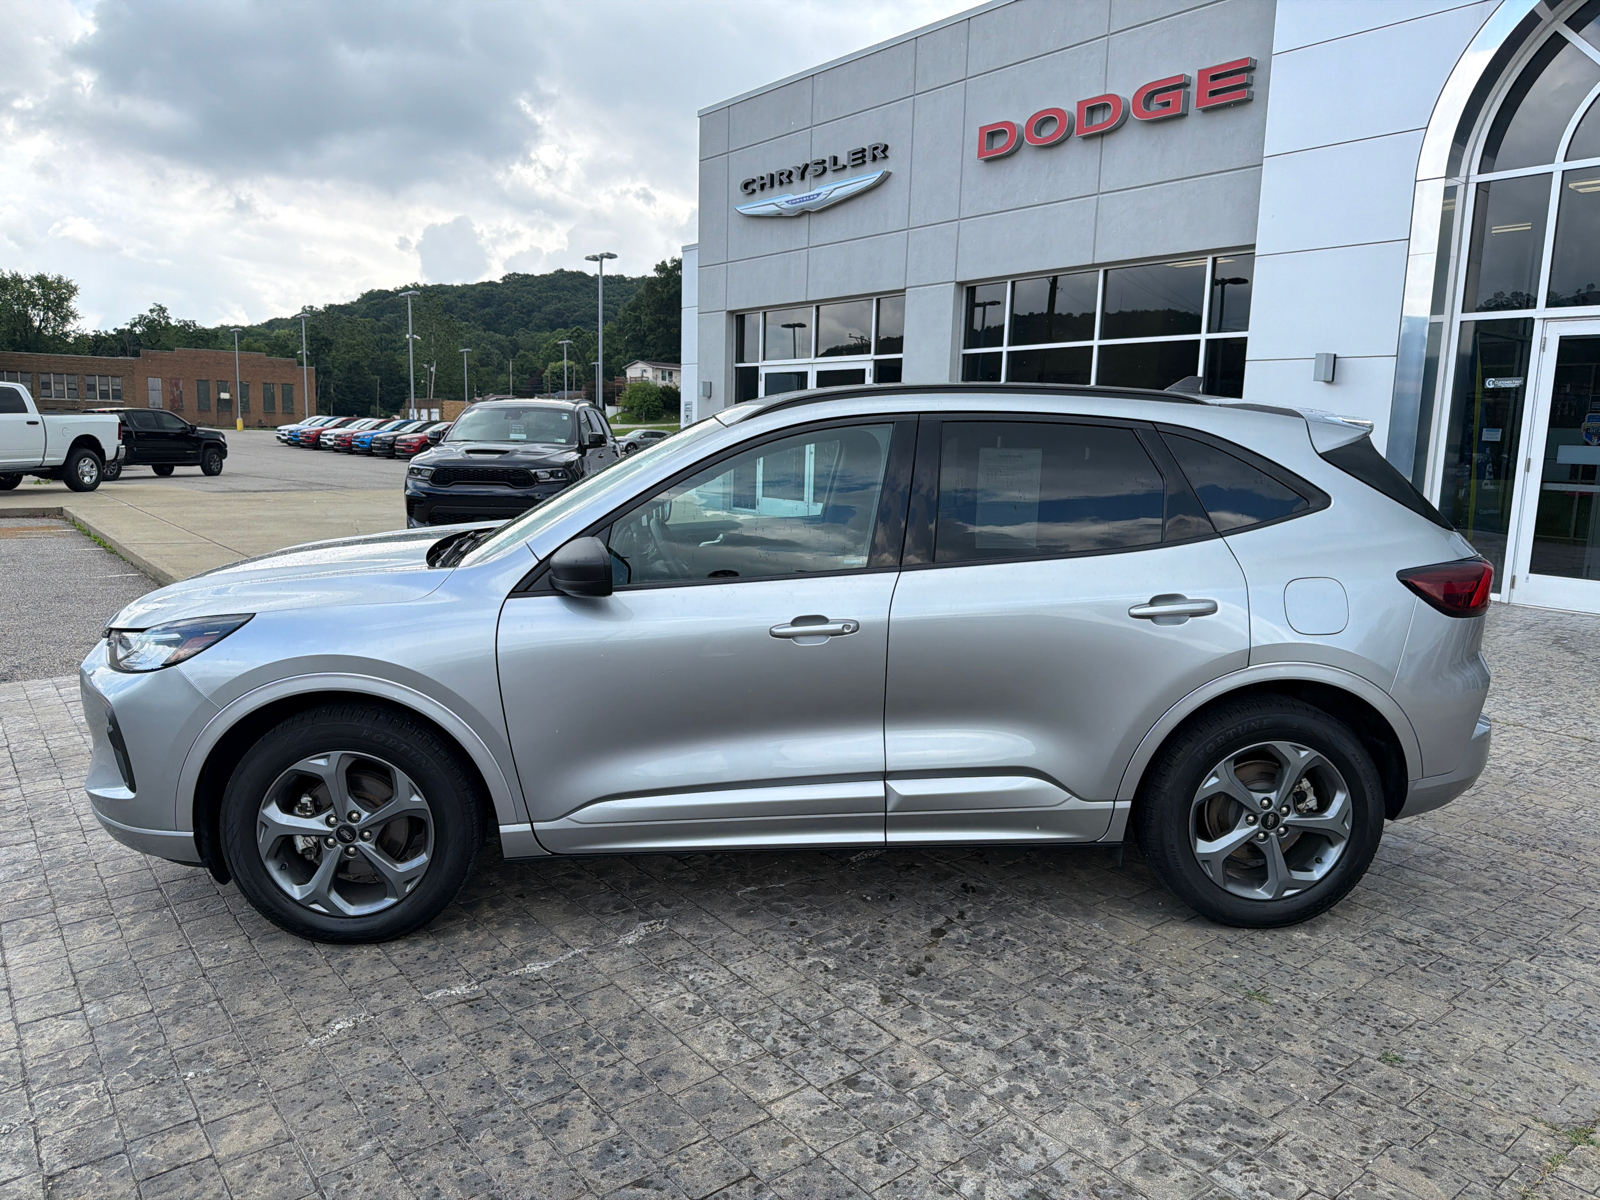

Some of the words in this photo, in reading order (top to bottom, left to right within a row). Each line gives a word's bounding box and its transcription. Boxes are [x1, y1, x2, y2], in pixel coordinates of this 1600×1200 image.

[977, 57, 1257, 162] DODGE
[740, 142, 890, 196] CHRYSLER
[788, 194, 818, 205] CHRYSLER
[359, 729, 439, 778] FORTUNE
[1197, 718, 1272, 762] FORTUNE
